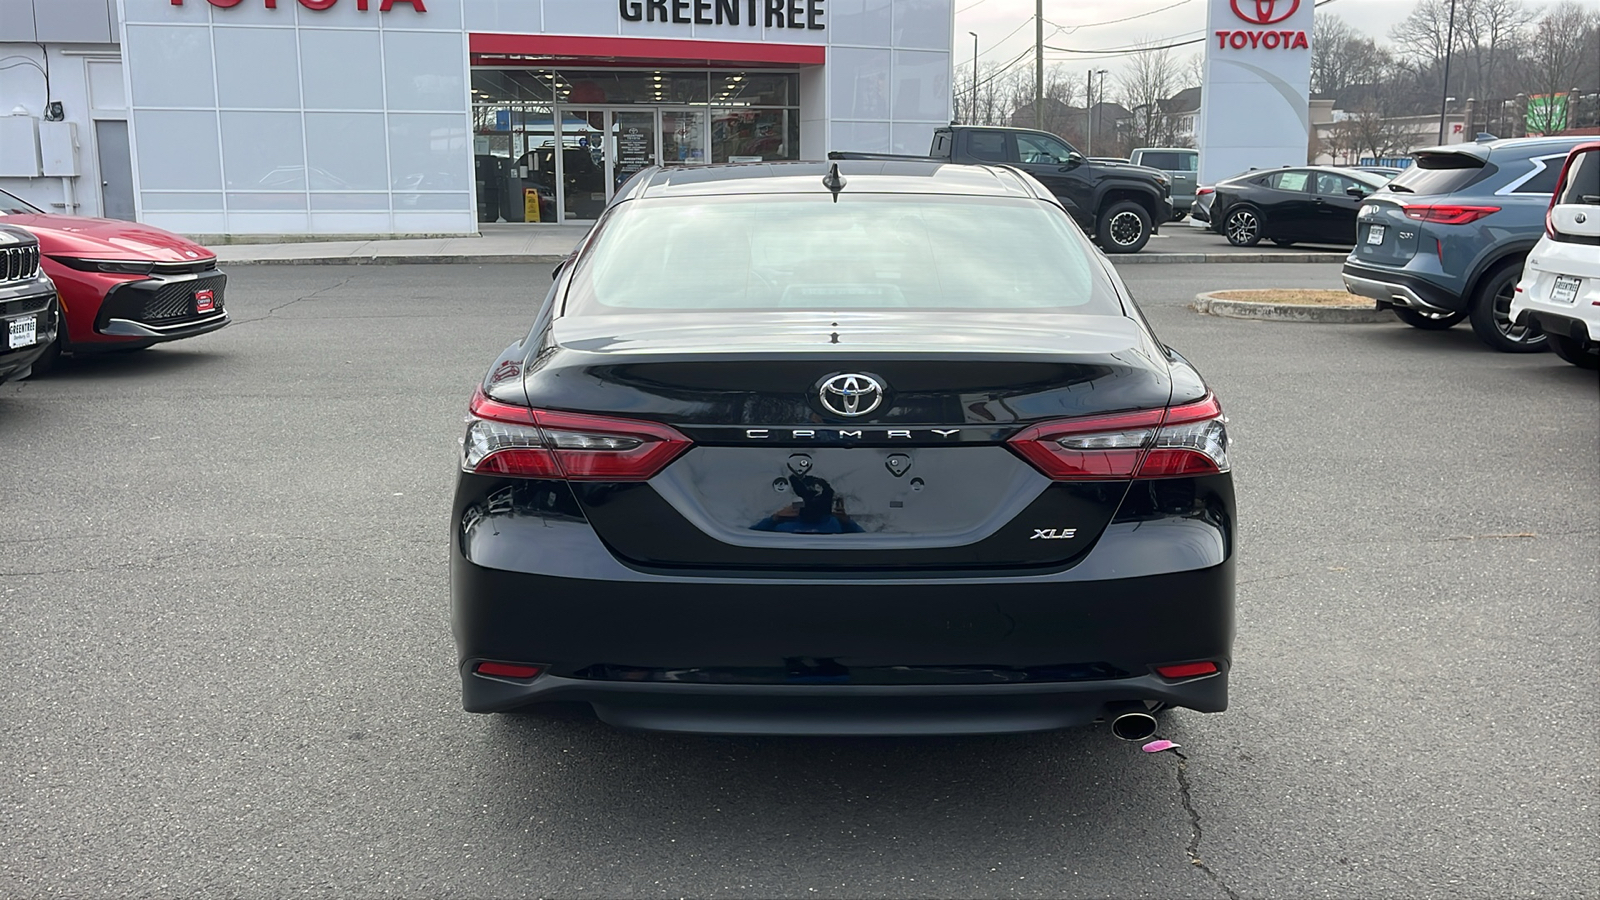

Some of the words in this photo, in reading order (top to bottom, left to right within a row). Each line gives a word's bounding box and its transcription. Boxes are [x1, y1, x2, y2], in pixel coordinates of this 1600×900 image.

[620, 0, 826, 30] GREENTREE
[1215, 30, 1309, 50] TOYOTA
[745, 428, 960, 440] CAMRY
[1029, 528, 1078, 540] XLE
